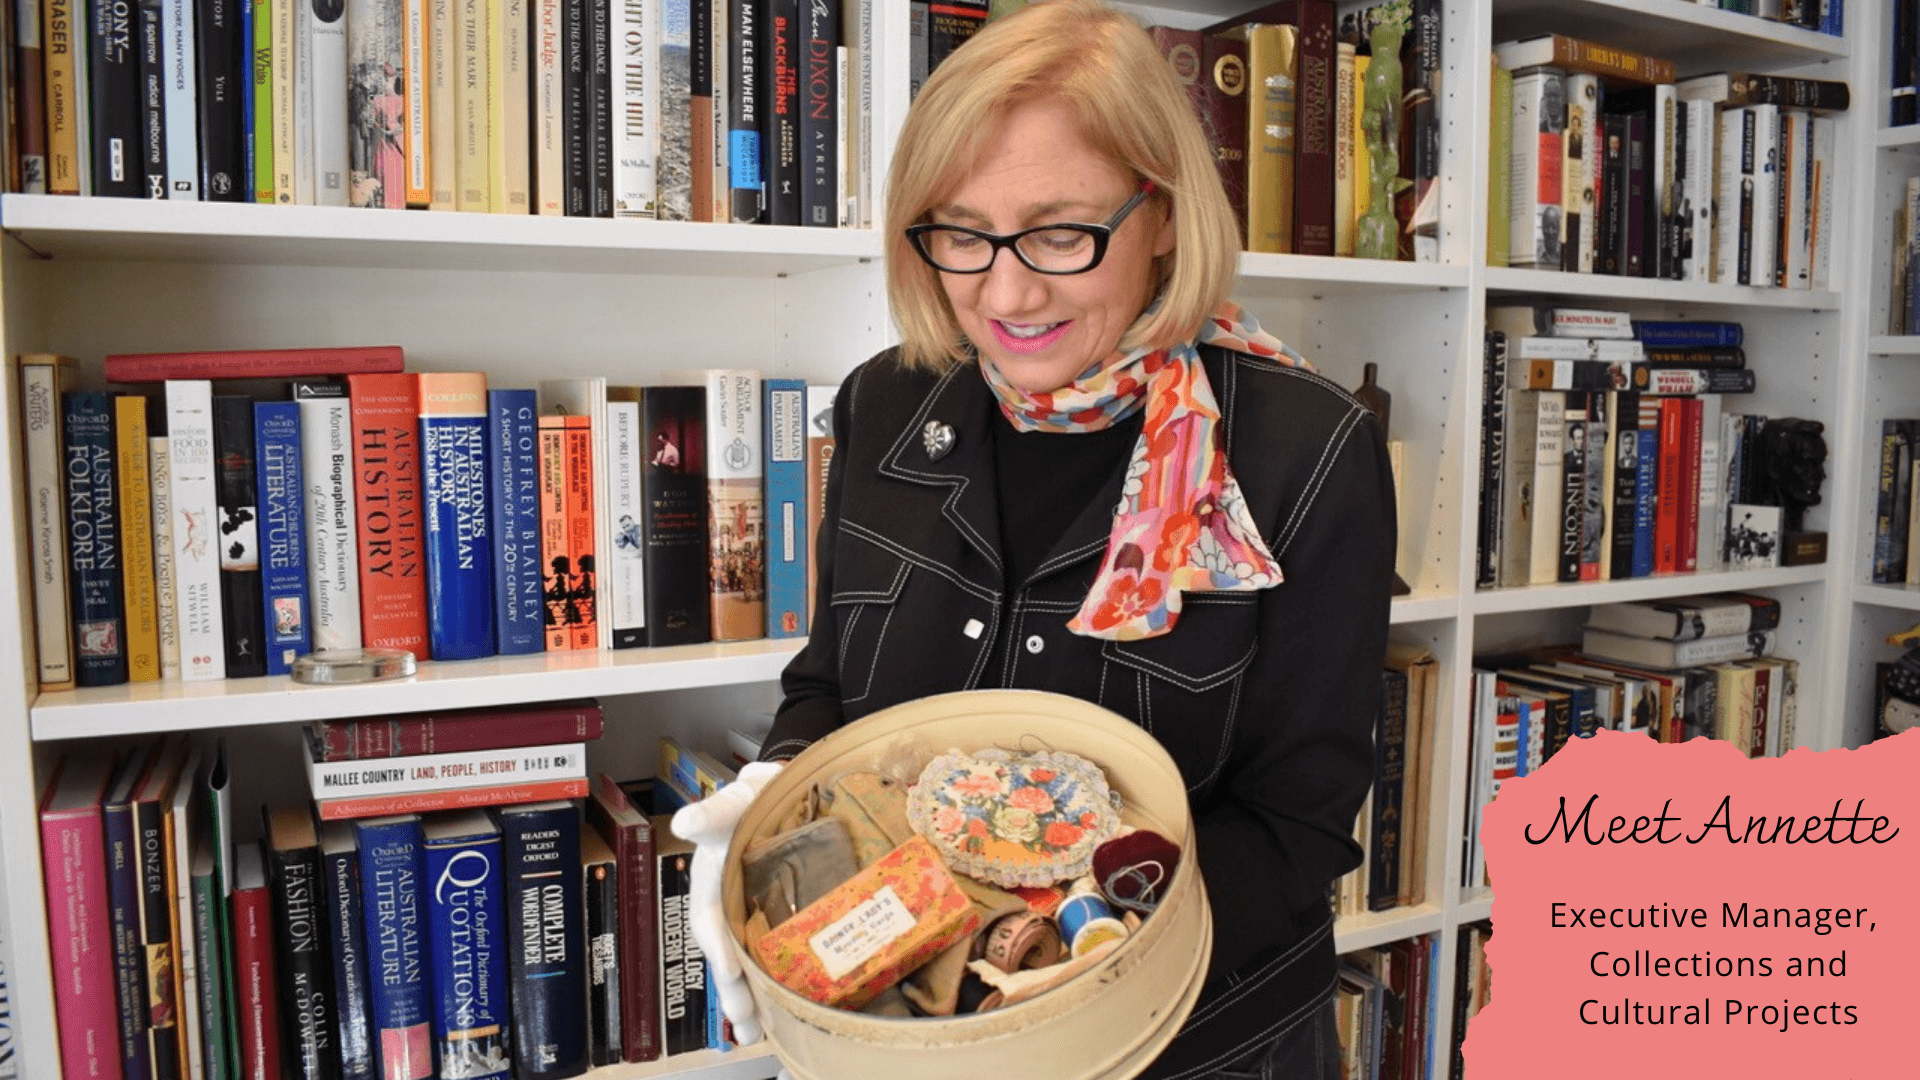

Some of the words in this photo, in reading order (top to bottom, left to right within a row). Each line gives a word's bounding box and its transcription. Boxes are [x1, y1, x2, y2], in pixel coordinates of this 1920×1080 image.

[466, 18, 476, 52] THEIR
[571, 21, 581, 40] THE
[595, 22, 605, 41] THE
[742, 4, 754, 35] MAN
[145, 24, 158, 64] sparrow
[175, 30, 184, 57] MANY
[571, 41, 581, 73] DANCE
[596, 42, 606, 74] DANCE
[625, 30, 643, 56] ON
[176, 59, 185, 91] VOICES
[467, 55, 478, 89] MARK
[625, 60, 643, 97] THE
[742, 38, 754, 122] ELSEWHERE
[774, 16, 787, 115] BLACKBURNS
[787, 66, 797, 95] THE
[809, 38, 830, 120] DIXON
[53, 83, 64, 133] CARROLL
[149, 75, 162, 108] radical
[573, 87, 581, 131] PAMELA
[597, 88, 606, 131] PAMELA
[1338, 68, 1348, 138] CHILDREN'S
[150, 111, 161, 164] melbourne
[625, 101, 644, 141] HILL
[1744, 114, 1754, 171] BROTHERS
[781, 119, 789, 168] RASMUSSEN
[815, 130, 825, 186] AYRES
[1337, 141, 1348, 181] BOOKS
[1672, 225, 1680, 258] DAVID
[719, 375, 729, 399] Gavin
[743, 375, 752, 399] ACTS
[1493, 340, 1507, 419] TWENTY
[29, 381, 42, 432] WRITERS
[67, 413, 110, 424] OXFORD
[501, 407, 510, 417] A
[719, 400, 729, 428] Souter
[735, 375, 746, 435] PARLIAMENT
[744, 401, 752, 413] OF
[772, 392, 784, 459] PARLIAMENT
[791, 392, 801, 459] AUSTRALIA'S
[172, 438, 209, 449] FOOD
[330, 407, 345, 451] Monash
[425, 425, 440, 451] 1788
[454, 425, 469, 448] IN
[502, 418, 512, 453] SHORT
[617, 411, 630, 461] BEFORE
[427, 453, 439, 467] to
[438, 425, 456, 507] HISTORY
[517, 407, 536, 520] GEOFFREY
[579, 432, 589, 472] DEMOCRACY
[1491, 430, 1505, 481] DAYS
[285, 442, 299, 508] AUSTRALIAN
[311, 485, 325, 499] of
[328, 453, 347, 530] Biographical
[428, 468, 440, 488] the
[468, 425, 486, 539] MILESTONES
[502, 455, 513, 500] HISTORY
[619, 462, 632, 508] RUPERT
[38, 487, 49, 525] Graeme
[68, 445, 95, 572] FOLKLORE
[91, 444, 116, 570] AUSTRALIAN
[156, 492, 169, 526] BOYS
[264, 444, 290, 570] LITERATURE
[314, 499, 328, 527] 20th
[362, 426, 394, 580] HISTORY
[392, 426, 418, 579] AUSTRALIAN
[429, 489, 441, 533] Present
[455, 450, 473, 570] AUSTRALIAN
[504, 502, 513, 518] OF
[554, 486, 563, 514] CONTROL
[580, 485, 589, 513] CONTROL
[1564, 472, 1582, 556] LINCOLN
[41, 527, 51, 558] Kinross
[314, 528, 329, 575] Century
[504, 520, 515, 540] THE
[43, 558, 54, 585] Smith
[81, 579, 111, 589] DAVEY
[334, 532, 349, 594] Dictionary
[521, 530, 540, 622] BLAINEY
[187, 584, 199, 635] SITWELL
[199, 583, 211, 635] WILLIAM
[318, 576, 333, 628] Australia
[506, 574, 518, 623] CENTURY
[372, 635, 422, 649] OXFORD
[1498, 727, 1518, 738] WHIT
[1751, 685, 1767, 752] FDR
[323, 772, 360, 788] MALLEE
[362, 767, 405, 785] COUNTRY
[411, 764, 438, 781] LAND,
[441, 762, 477, 778] PEOPLE,
[479, 759, 517, 775] HISTORY
[1495, 755, 1517, 766] HOUS
[370, 842, 414, 857] OXFORD
[520, 829, 561, 842] READER'S
[522, 851, 560, 863] OXFORD
[525, 840, 556, 852] DIGEST
[145, 828, 161, 894] BONZER
[335, 857, 348, 893] Oxford
[284, 862, 313, 954] FASHION
[337, 893, 352, 943] Dictionary
[473, 887, 487, 908] The
[374, 869, 401, 987] LITERATURE
[397, 867, 422, 984] AUSTRALIAN
[435, 850, 491, 1028] QUOTATIONS
[471, 910, 492, 949] Oxford
[521, 885, 543, 967] WORDFINDER
[542, 883, 567, 965] COMPLETE
[663, 894, 685, 963] MODERN
[342, 942, 354, 952] of
[591, 933, 605, 986] THESAURUS
[602, 932, 616, 970] ROGET'S
[475, 950, 492, 1007] Dictionary
[665, 963, 686, 1020] WORLD
[293, 972, 316, 1075] McDOWELL
[311, 991, 329, 1051] COLIN
[476, 1009, 495, 1023] of
